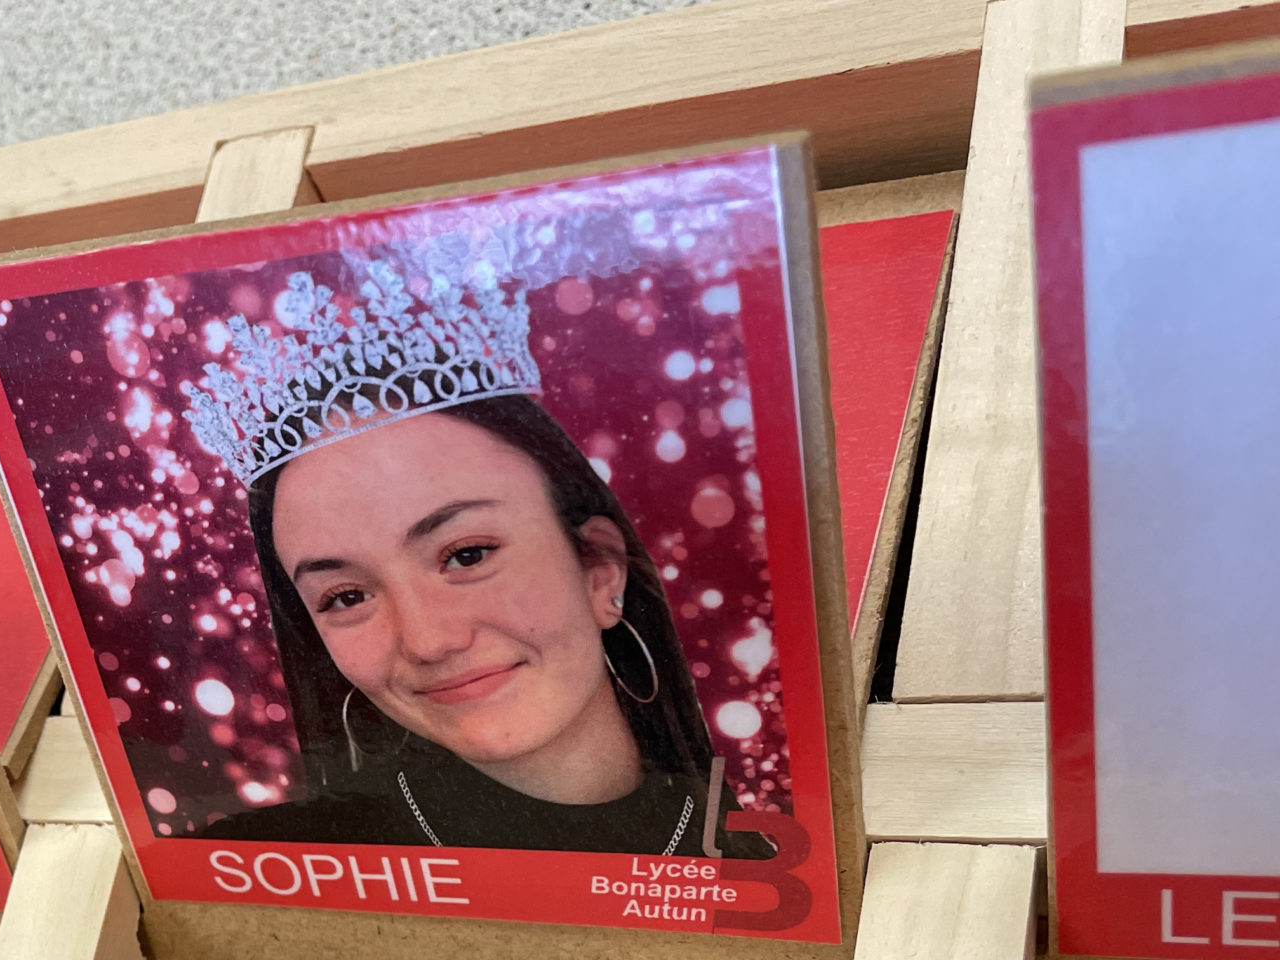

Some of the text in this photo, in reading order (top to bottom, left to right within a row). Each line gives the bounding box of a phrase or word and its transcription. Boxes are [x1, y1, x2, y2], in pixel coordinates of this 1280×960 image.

[209, 850, 469, 904] SOPHIE
[631, 857, 717, 881] Lycée
[591, 876, 738, 903] Bonaparte
[622, 899, 707, 922] Autun
